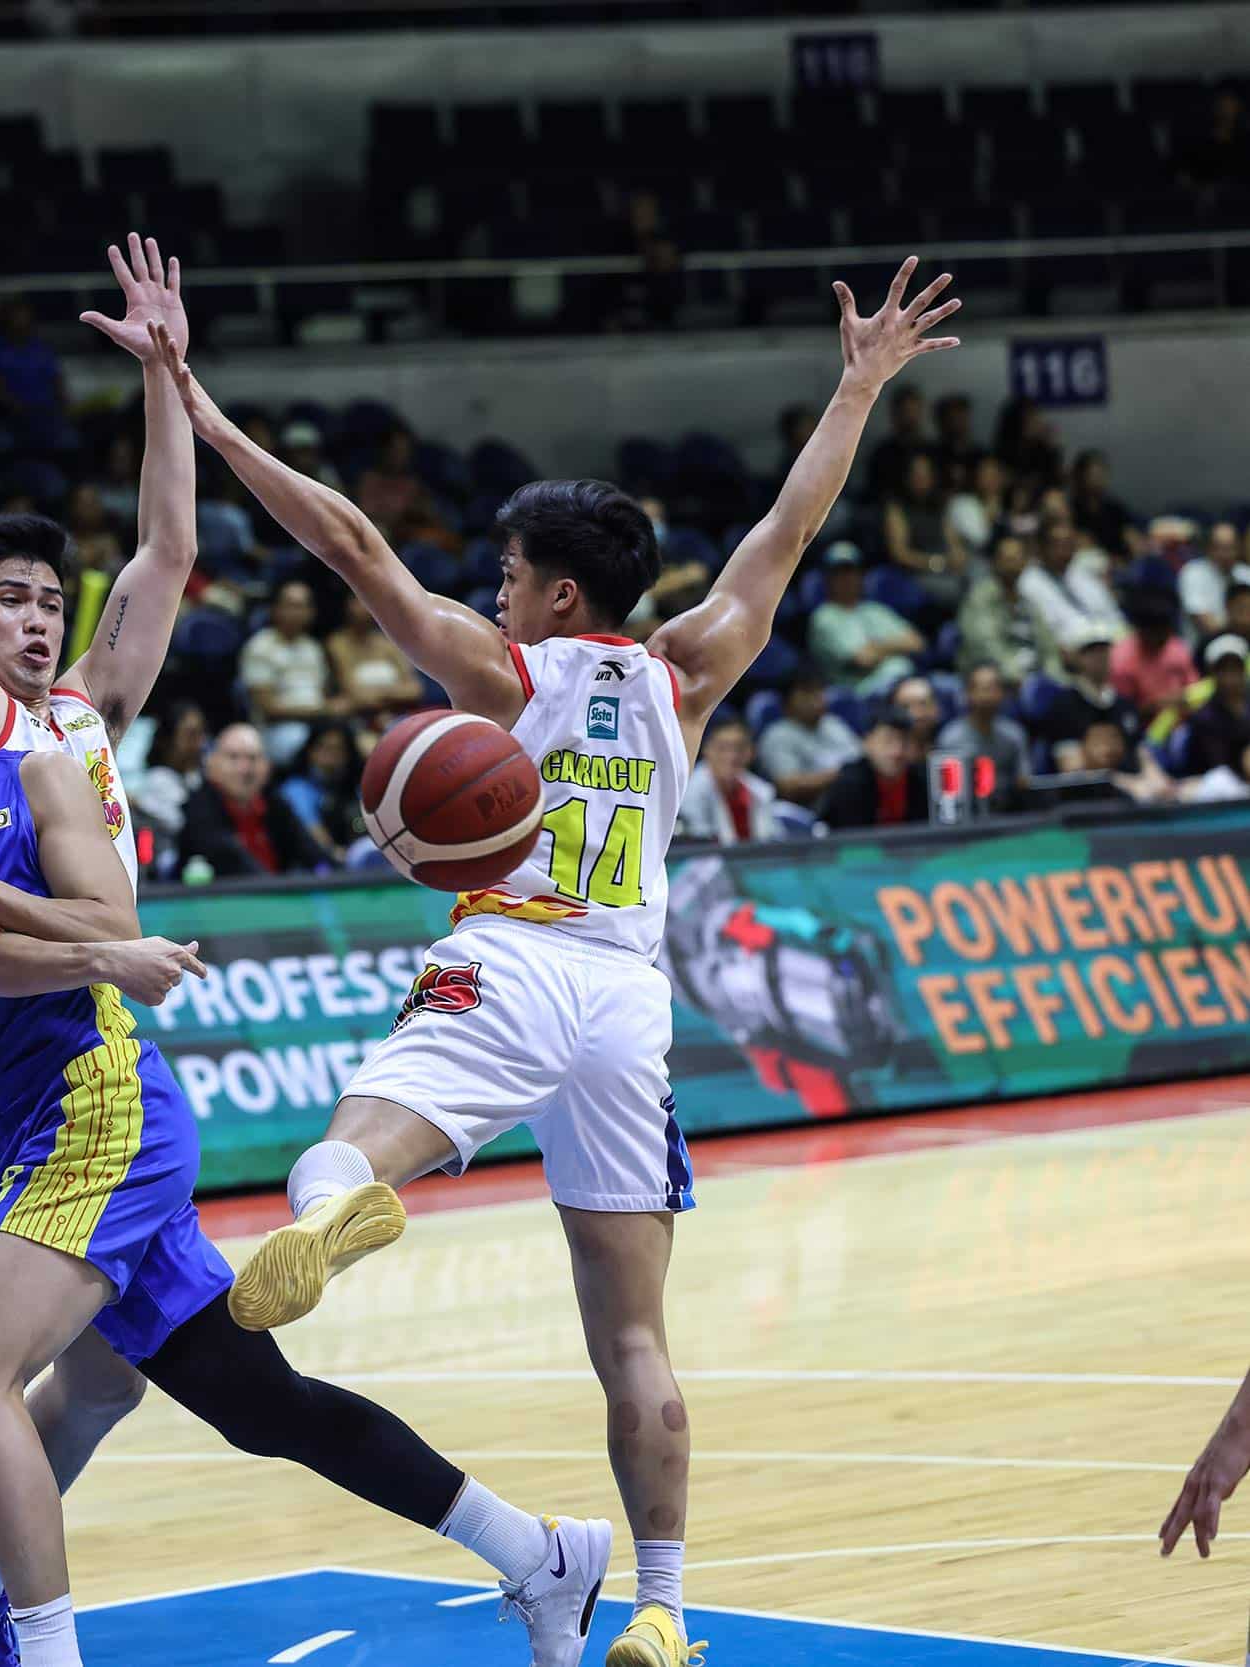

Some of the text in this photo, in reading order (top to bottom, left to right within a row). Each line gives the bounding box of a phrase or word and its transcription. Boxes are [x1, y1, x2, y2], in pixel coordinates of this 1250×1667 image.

[1018, 349, 1099, 397] 116
[591, 707, 612, 721] Sista
[540, 749, 656, 795] CARACUT
[542, 797, 647, 908] 14
[152, 944, 428, 1031] PROFESS
[917, 943, 1250, 1054] EFFICIEN
